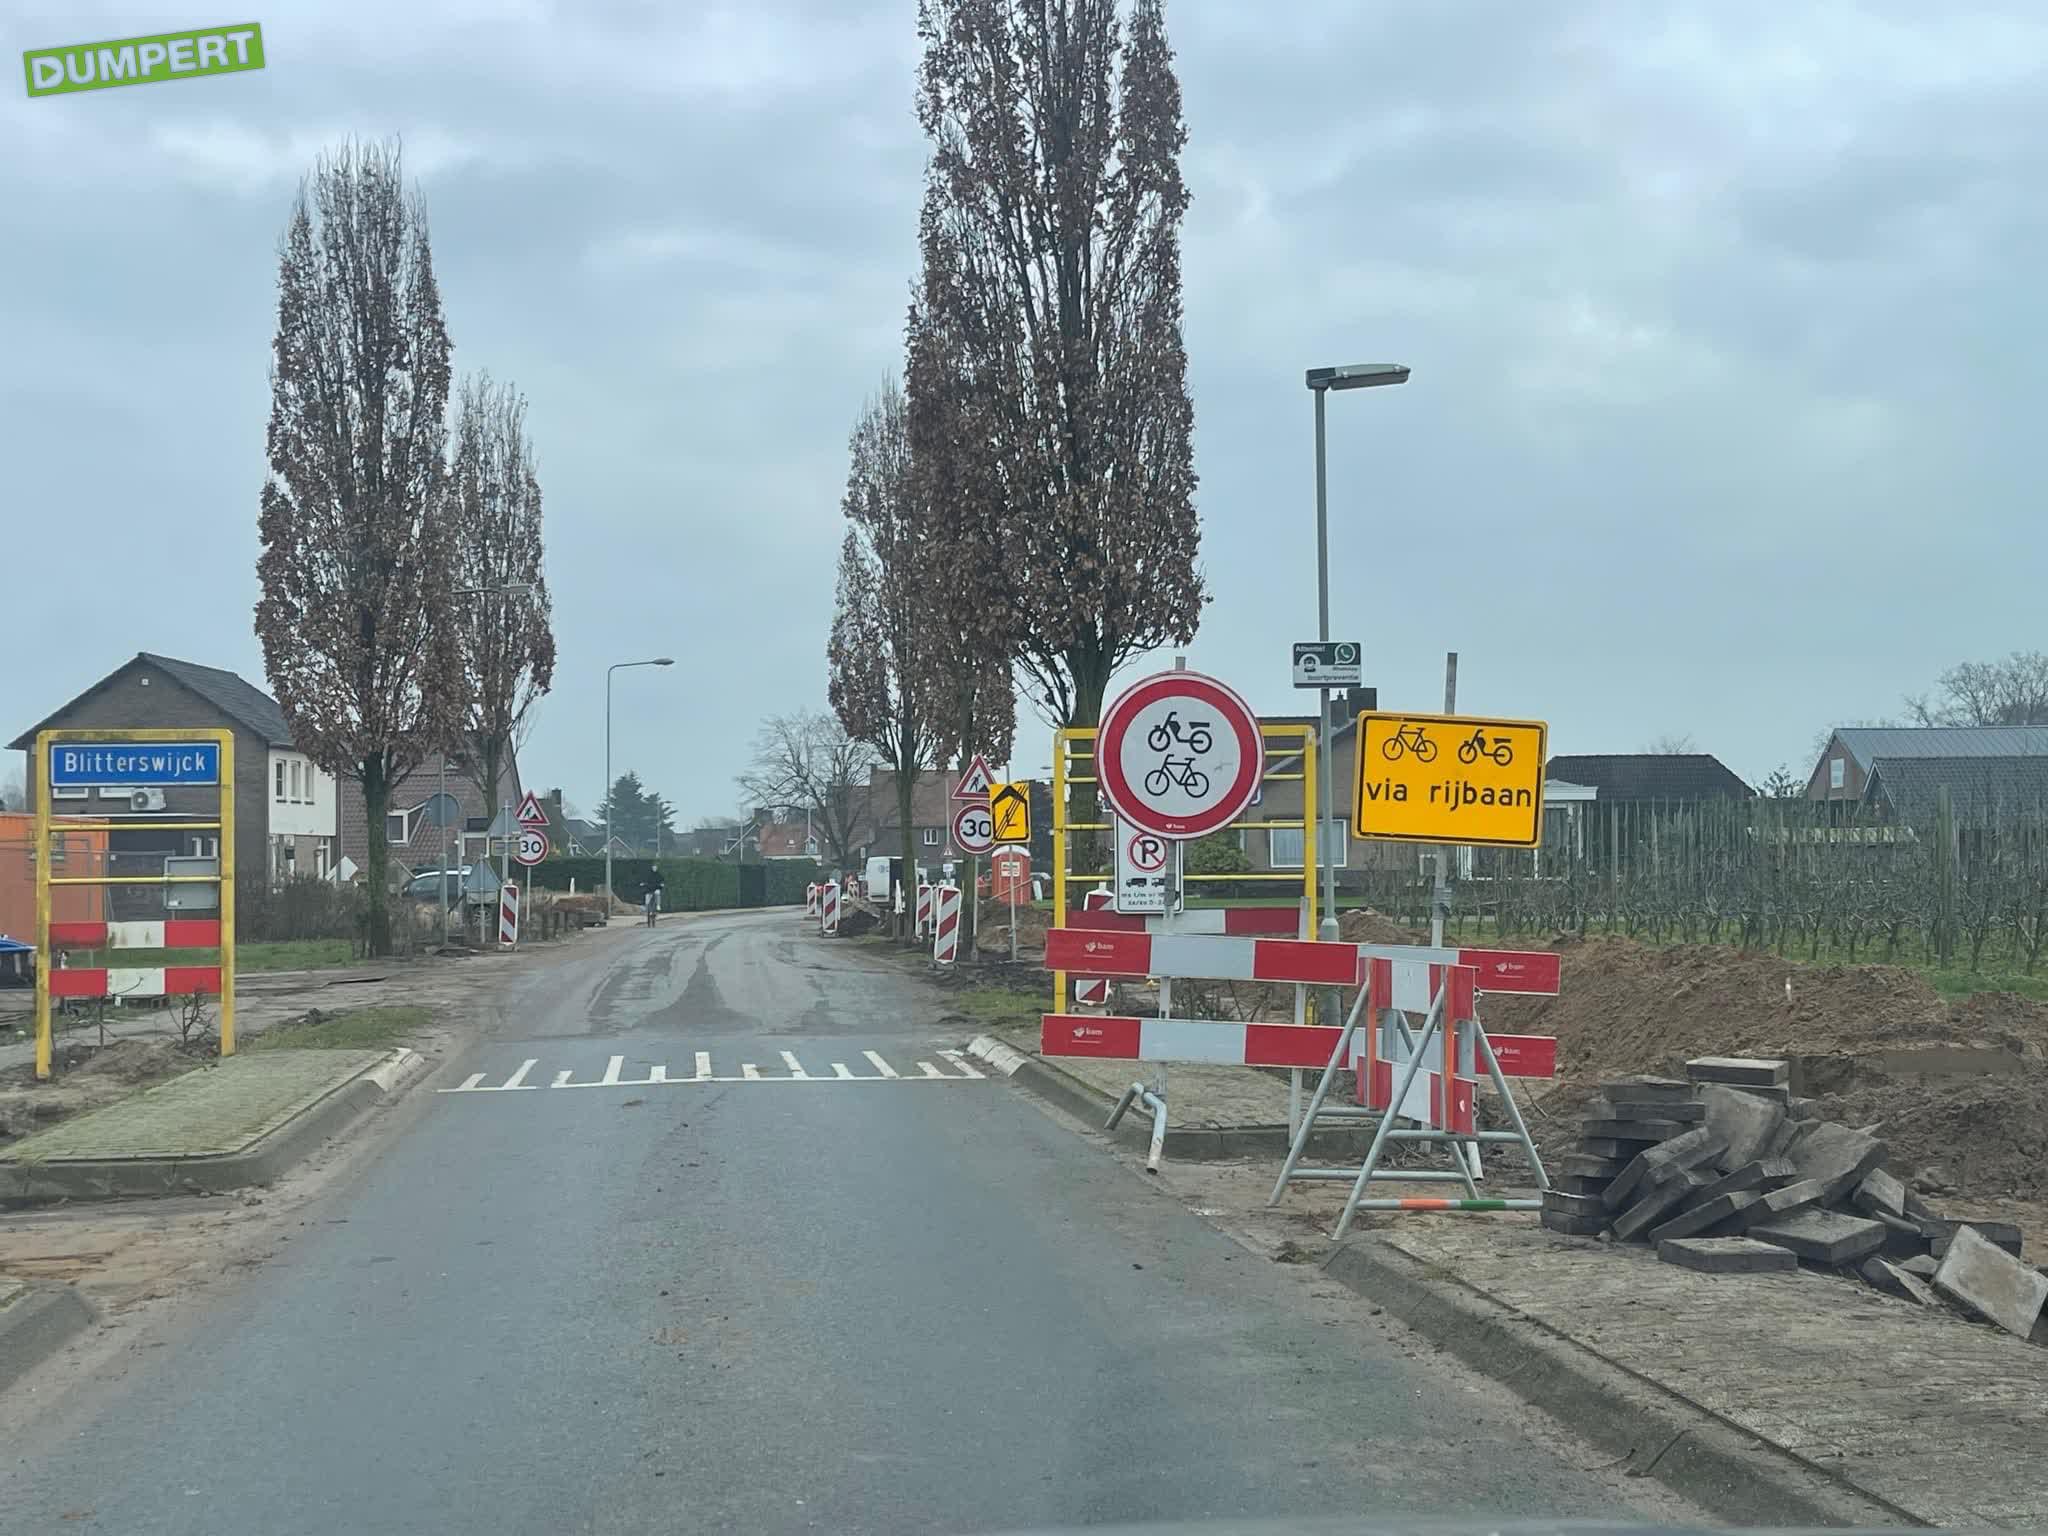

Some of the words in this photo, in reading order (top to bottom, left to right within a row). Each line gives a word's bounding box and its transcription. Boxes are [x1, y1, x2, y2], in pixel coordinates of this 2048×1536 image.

[64, 752, 206, 777] Blitterswijck
[1366, 778, 1409, 802] via
[1430, 780, 1532, 811] rijbaan
[962, 819, 992, 837] 30
[521, 840, 542, 853] 30
[1141, 840, 1159, 864] P
[1097, 941, 1114, 951] bam
[1086, 1026, 1103, 1036] bam
